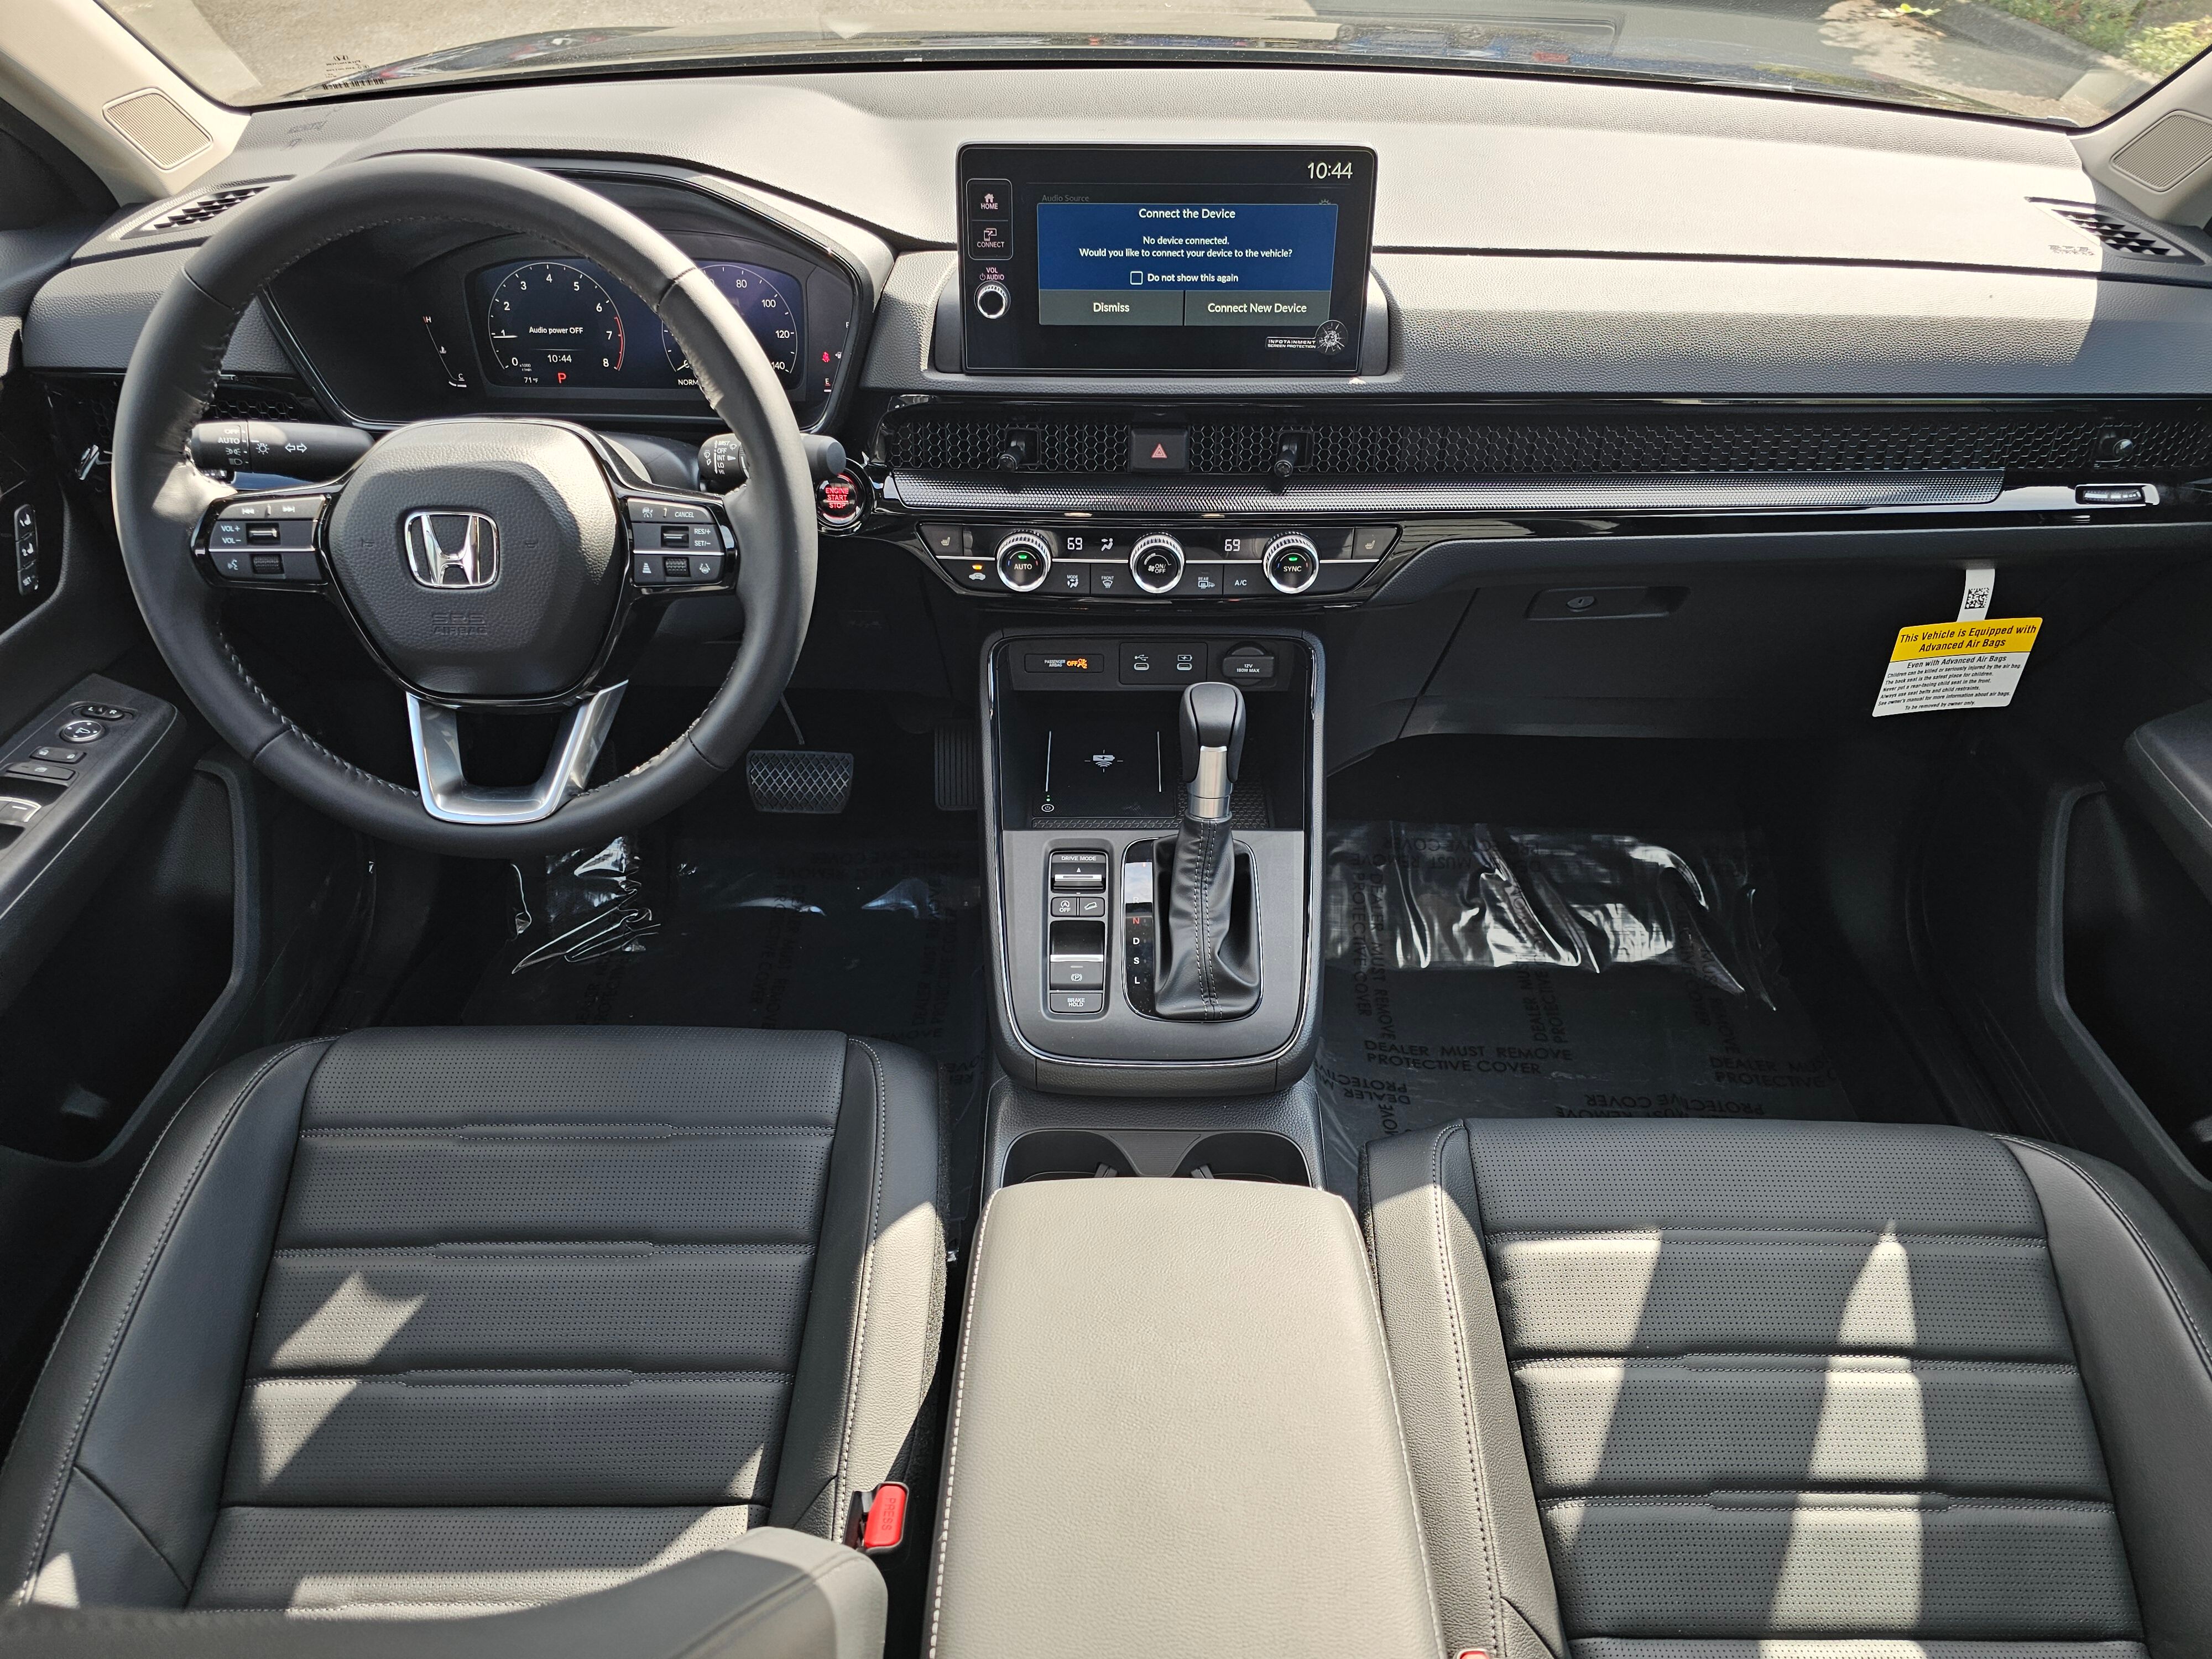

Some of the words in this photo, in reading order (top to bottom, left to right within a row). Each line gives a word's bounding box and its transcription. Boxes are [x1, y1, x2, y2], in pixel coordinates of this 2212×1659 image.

[1307, 162, 1353, 179] 10:44
[1139, 208, 1180, 218] Connect
[1182, 208, 1199, 218] the
[1202, 208, 1236, 218] Device
[1143, 237, 1155, 245] No
[1157, 236, 1183, 245] device
[1185, 236, 1230, 245] connected.
[1079, 248, 1107, 257] Would
[1108, 249, 1124, 258] you
[1125, 248, 1139, 257] like
[1207, 249, 1233, 257] device
[1245, 249, 1259, 257] the
[1260, 249, 1292, 258] vehicle?
[546, 274, 552, 283] 4
[1177, 273, 1198, 282] show
[1200, 273, 1215, 282] this
[1217, 274, 1239, 283] again
[520, 281, 527, 290] 3
[573, 282, 580, 291] 5
[736, 280, 747, 288] 80
[504, 302, 510, 311] 2
[596, 303, 602, 312] 6
[761, 299, 776, 308] 100
[1093, 302, 1130, 313] Dismiss
[1207, 303, 1247, 313] Connect
[1250, 304, 1272, 313] New
[1274, 303, 1307, 313] Device
[606, 331, 612, 340] 7
[775, 330, 790, 338] 120
[512, 357, 518, 366] 0
[547, 355, 572, 363] 10:44
[603, 358, 609, 367] 8
[771, 362, 785, 371] 140
[557, 373, 567, 384] P
[1067, 538, 1083, 550] 69
[1225, 539, 1240, 552] 69
[1901, 634, 1918, 643] This
[1922, 630, 1955, 641] Vehicle
[1958, 629, 1966, 637] is
[1969, 625, 2013, 638] Equipped
[2016, 625, 2037, 634] with
[1918, 640, 1965, 653] Advanced
[1965, 639, 1980, 648] Air
[1982, 639, 2006, 648] Bags
[1941, 656, 1976, 665] Advanced
[1363, 1040, 1430, 1056] DEALER
[1440, 1045, 1485, 1057] MUST
[1496, 1047, 1573, 1061] REMOVE
[1366, 1053, 1472, 1071] PROTECTIVE
[1477, 1060, 1542, 1074] COVER
[881, 1498, 896, 1531] PRESS
